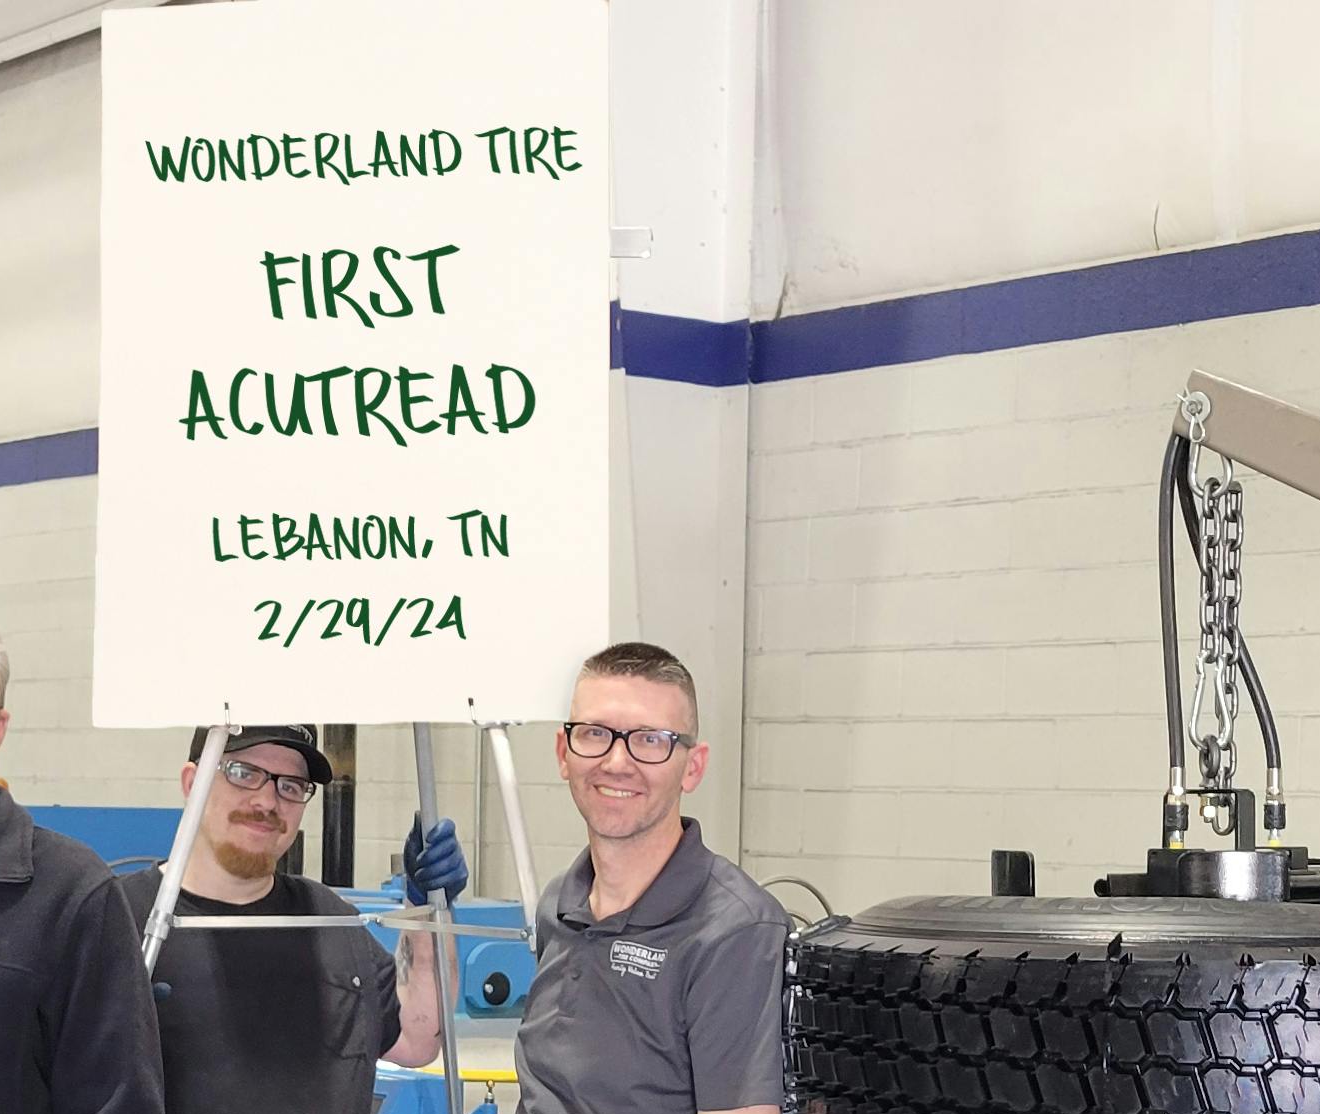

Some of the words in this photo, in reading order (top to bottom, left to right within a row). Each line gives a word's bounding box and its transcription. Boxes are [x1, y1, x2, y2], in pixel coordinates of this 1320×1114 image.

[145, 129, 461, 185] WONDERLAND
[475, 126, 582, 180] TIRE
[260, 245, 460, 328] FIRST
[179, 364, 535, 447] ACUTREAD
[213, 513, 433, 562] LEBANON,
[447, 510, 509, 557] TN
[254, 595, 466, 647] 2/29/24
